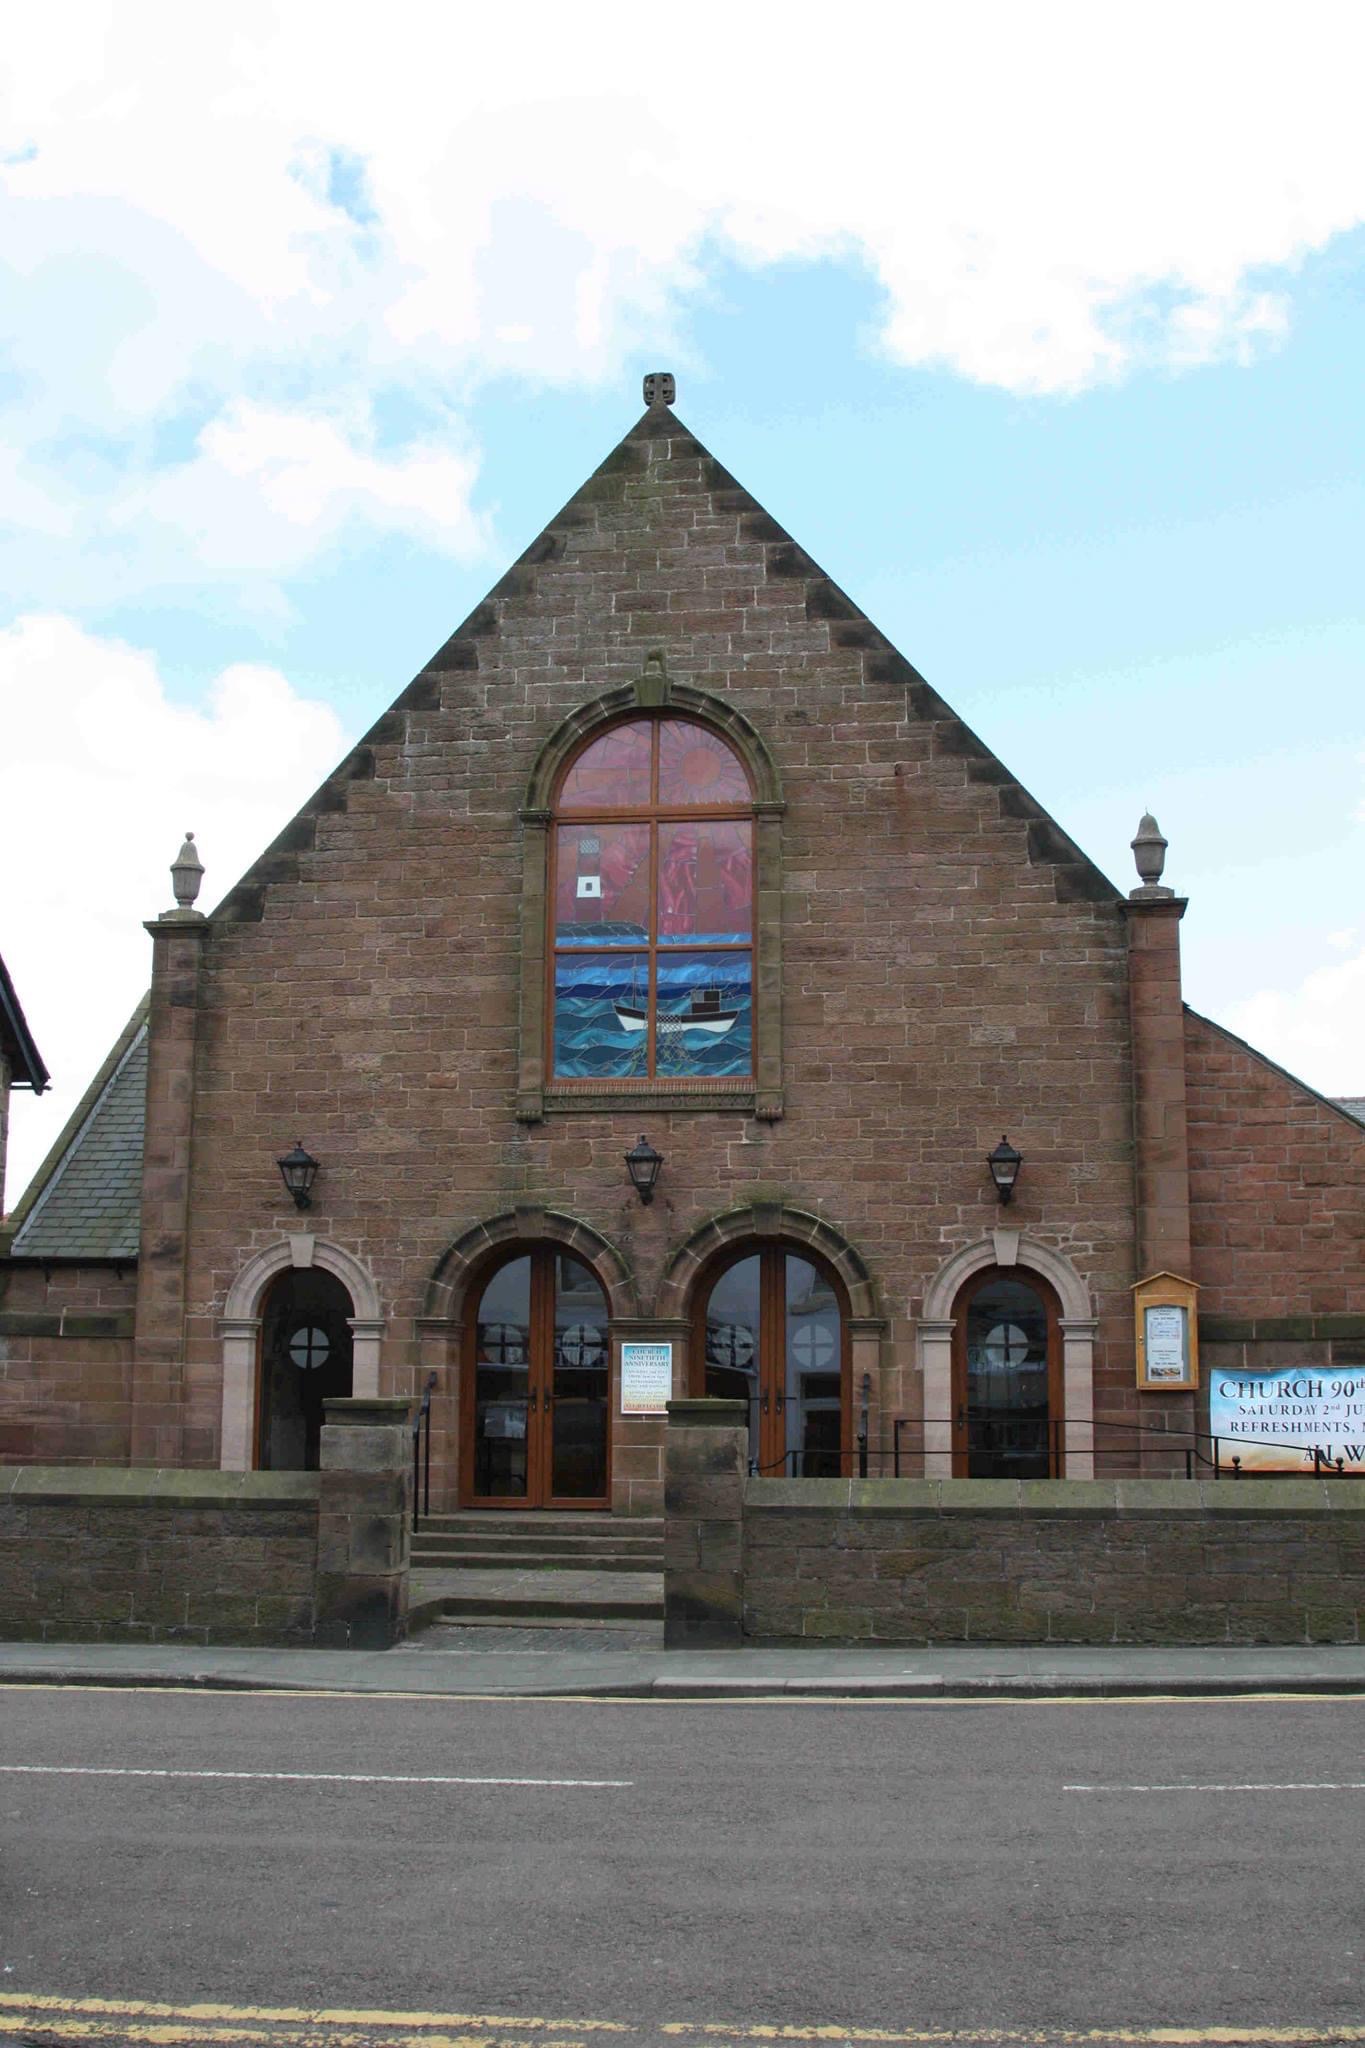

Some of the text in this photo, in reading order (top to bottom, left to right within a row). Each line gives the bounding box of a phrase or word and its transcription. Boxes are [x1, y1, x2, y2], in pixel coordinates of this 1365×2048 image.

[1219, 1380, 1323, 1399] CHURCH
[1239, 1403, 1365, 1418] SATURDAY 2nd JU
[1230, 1421, 1356, 1433] REFRESHMENTS,
